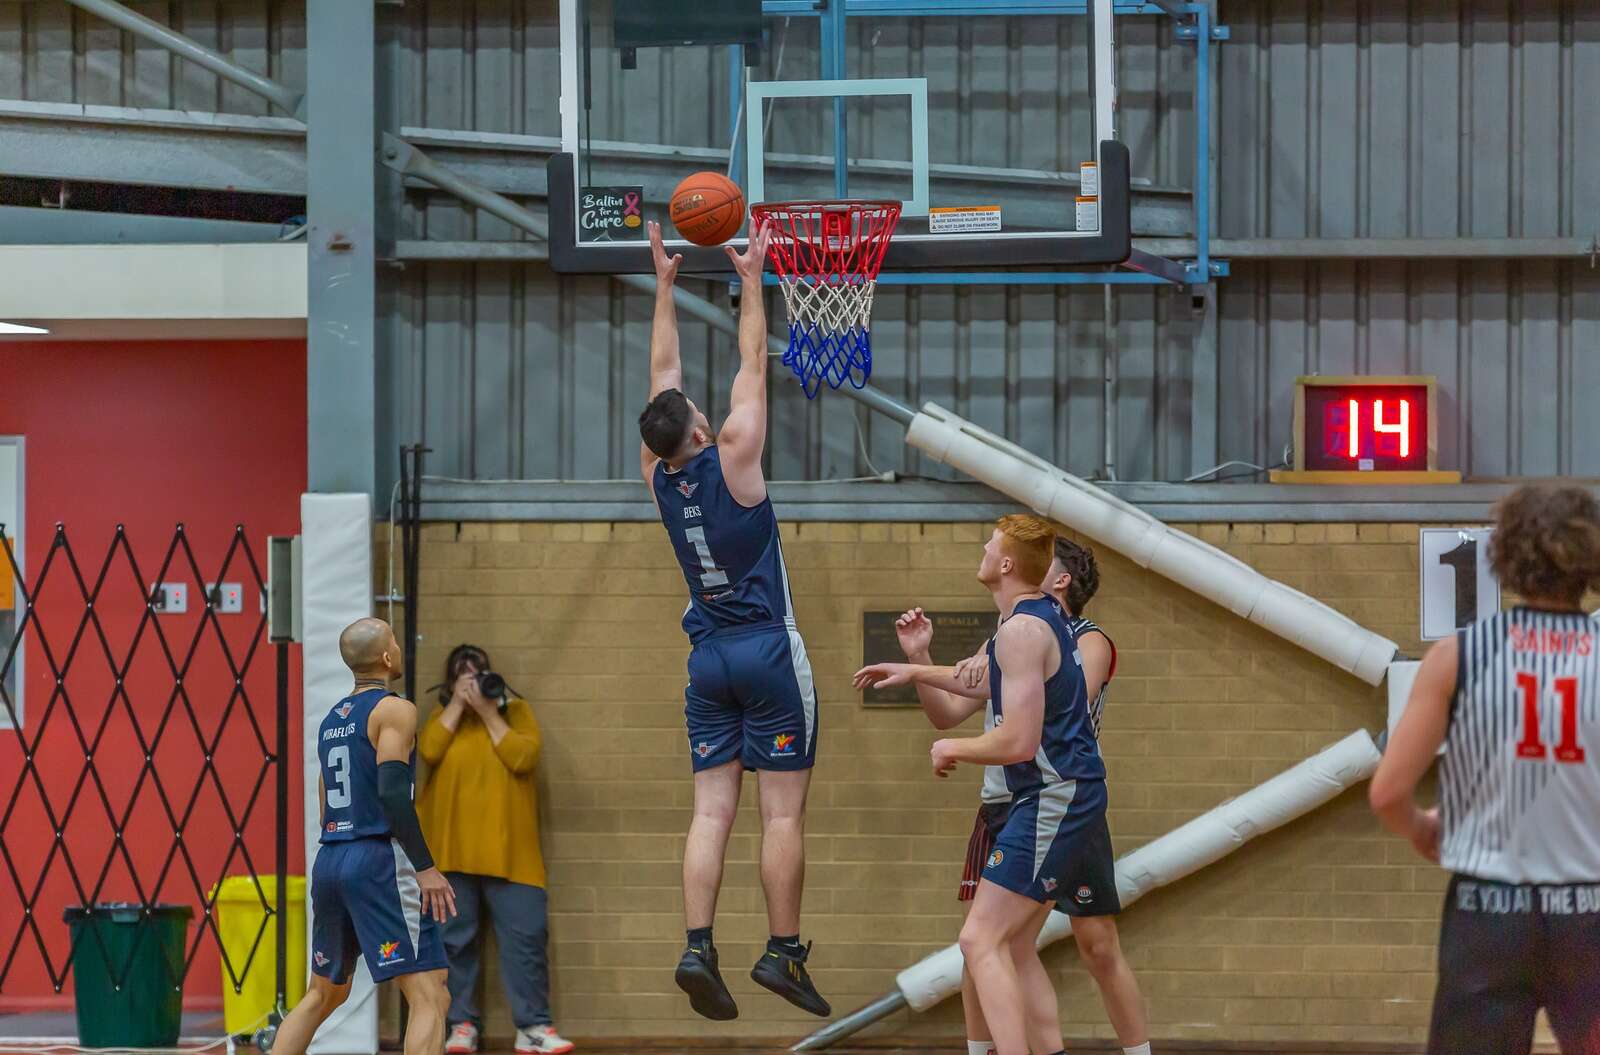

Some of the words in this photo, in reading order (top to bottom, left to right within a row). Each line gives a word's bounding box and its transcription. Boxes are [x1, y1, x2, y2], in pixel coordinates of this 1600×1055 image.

[582, 194, 624, 208] Ballin
[599, 206, 612, 216] for
[581, 210, 624, 229] Cure
[1349, 399, 1410, 458] 14
[684, 505, 702, 519] BEKS
[685, 525, 729, 588] 1
[1439, 539, 1478, 628] 1
[1508, 622, 1593, 656] SAINTS
[1516, 671, 1586, 764] 11
[326, 744, 352, 809] 3
[1539, 886, 1574, 915] THE
